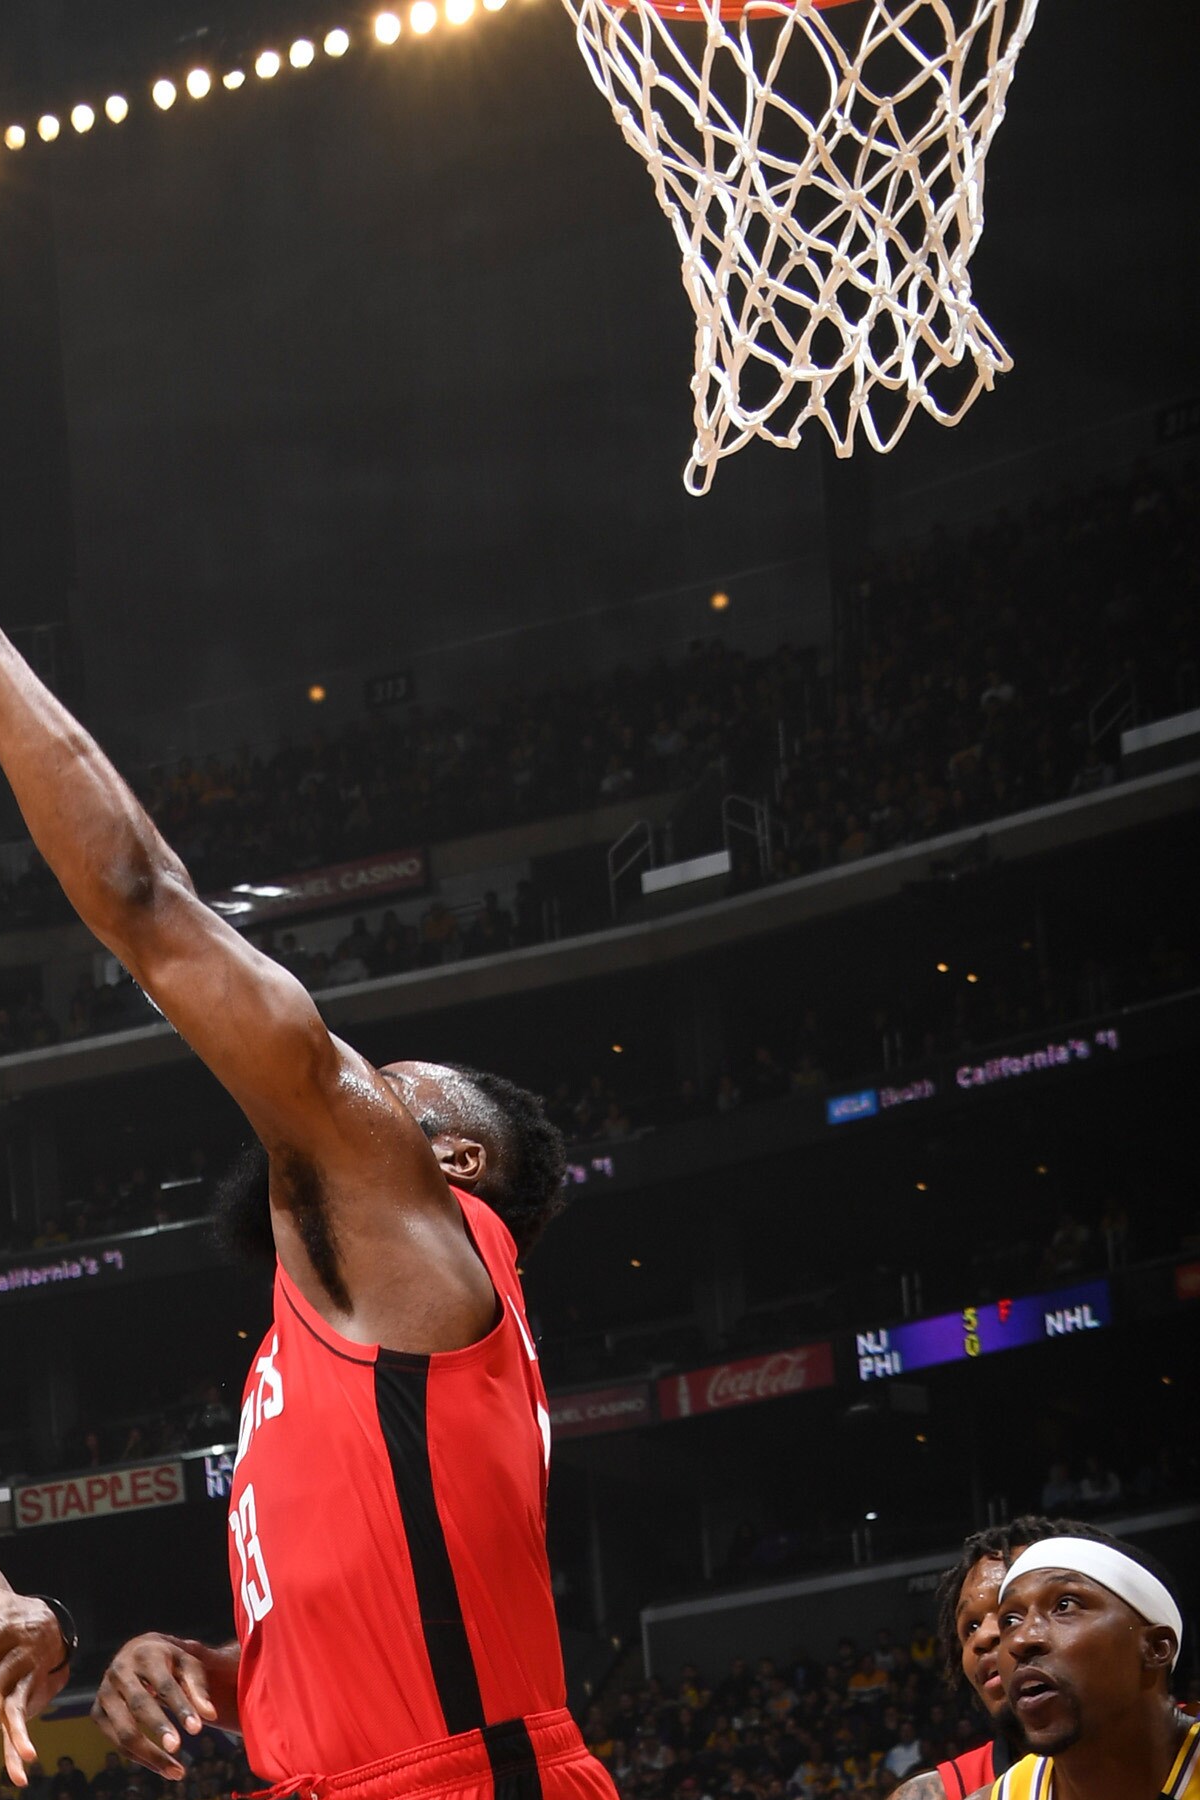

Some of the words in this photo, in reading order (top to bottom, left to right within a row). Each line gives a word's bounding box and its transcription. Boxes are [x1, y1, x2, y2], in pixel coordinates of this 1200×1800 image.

[341, 857, 421, 890] CASINO
[956, 1038, 1091, 1088] California's
[856, 1328, 888, 1356] NJ
[963, 1306, 977, 1332] 5
[1045, 1304, 1100, 1337] NHL
[859, 1352, 901, 1381] PHI
[19, 1466, 178, 1524] STAPLES
